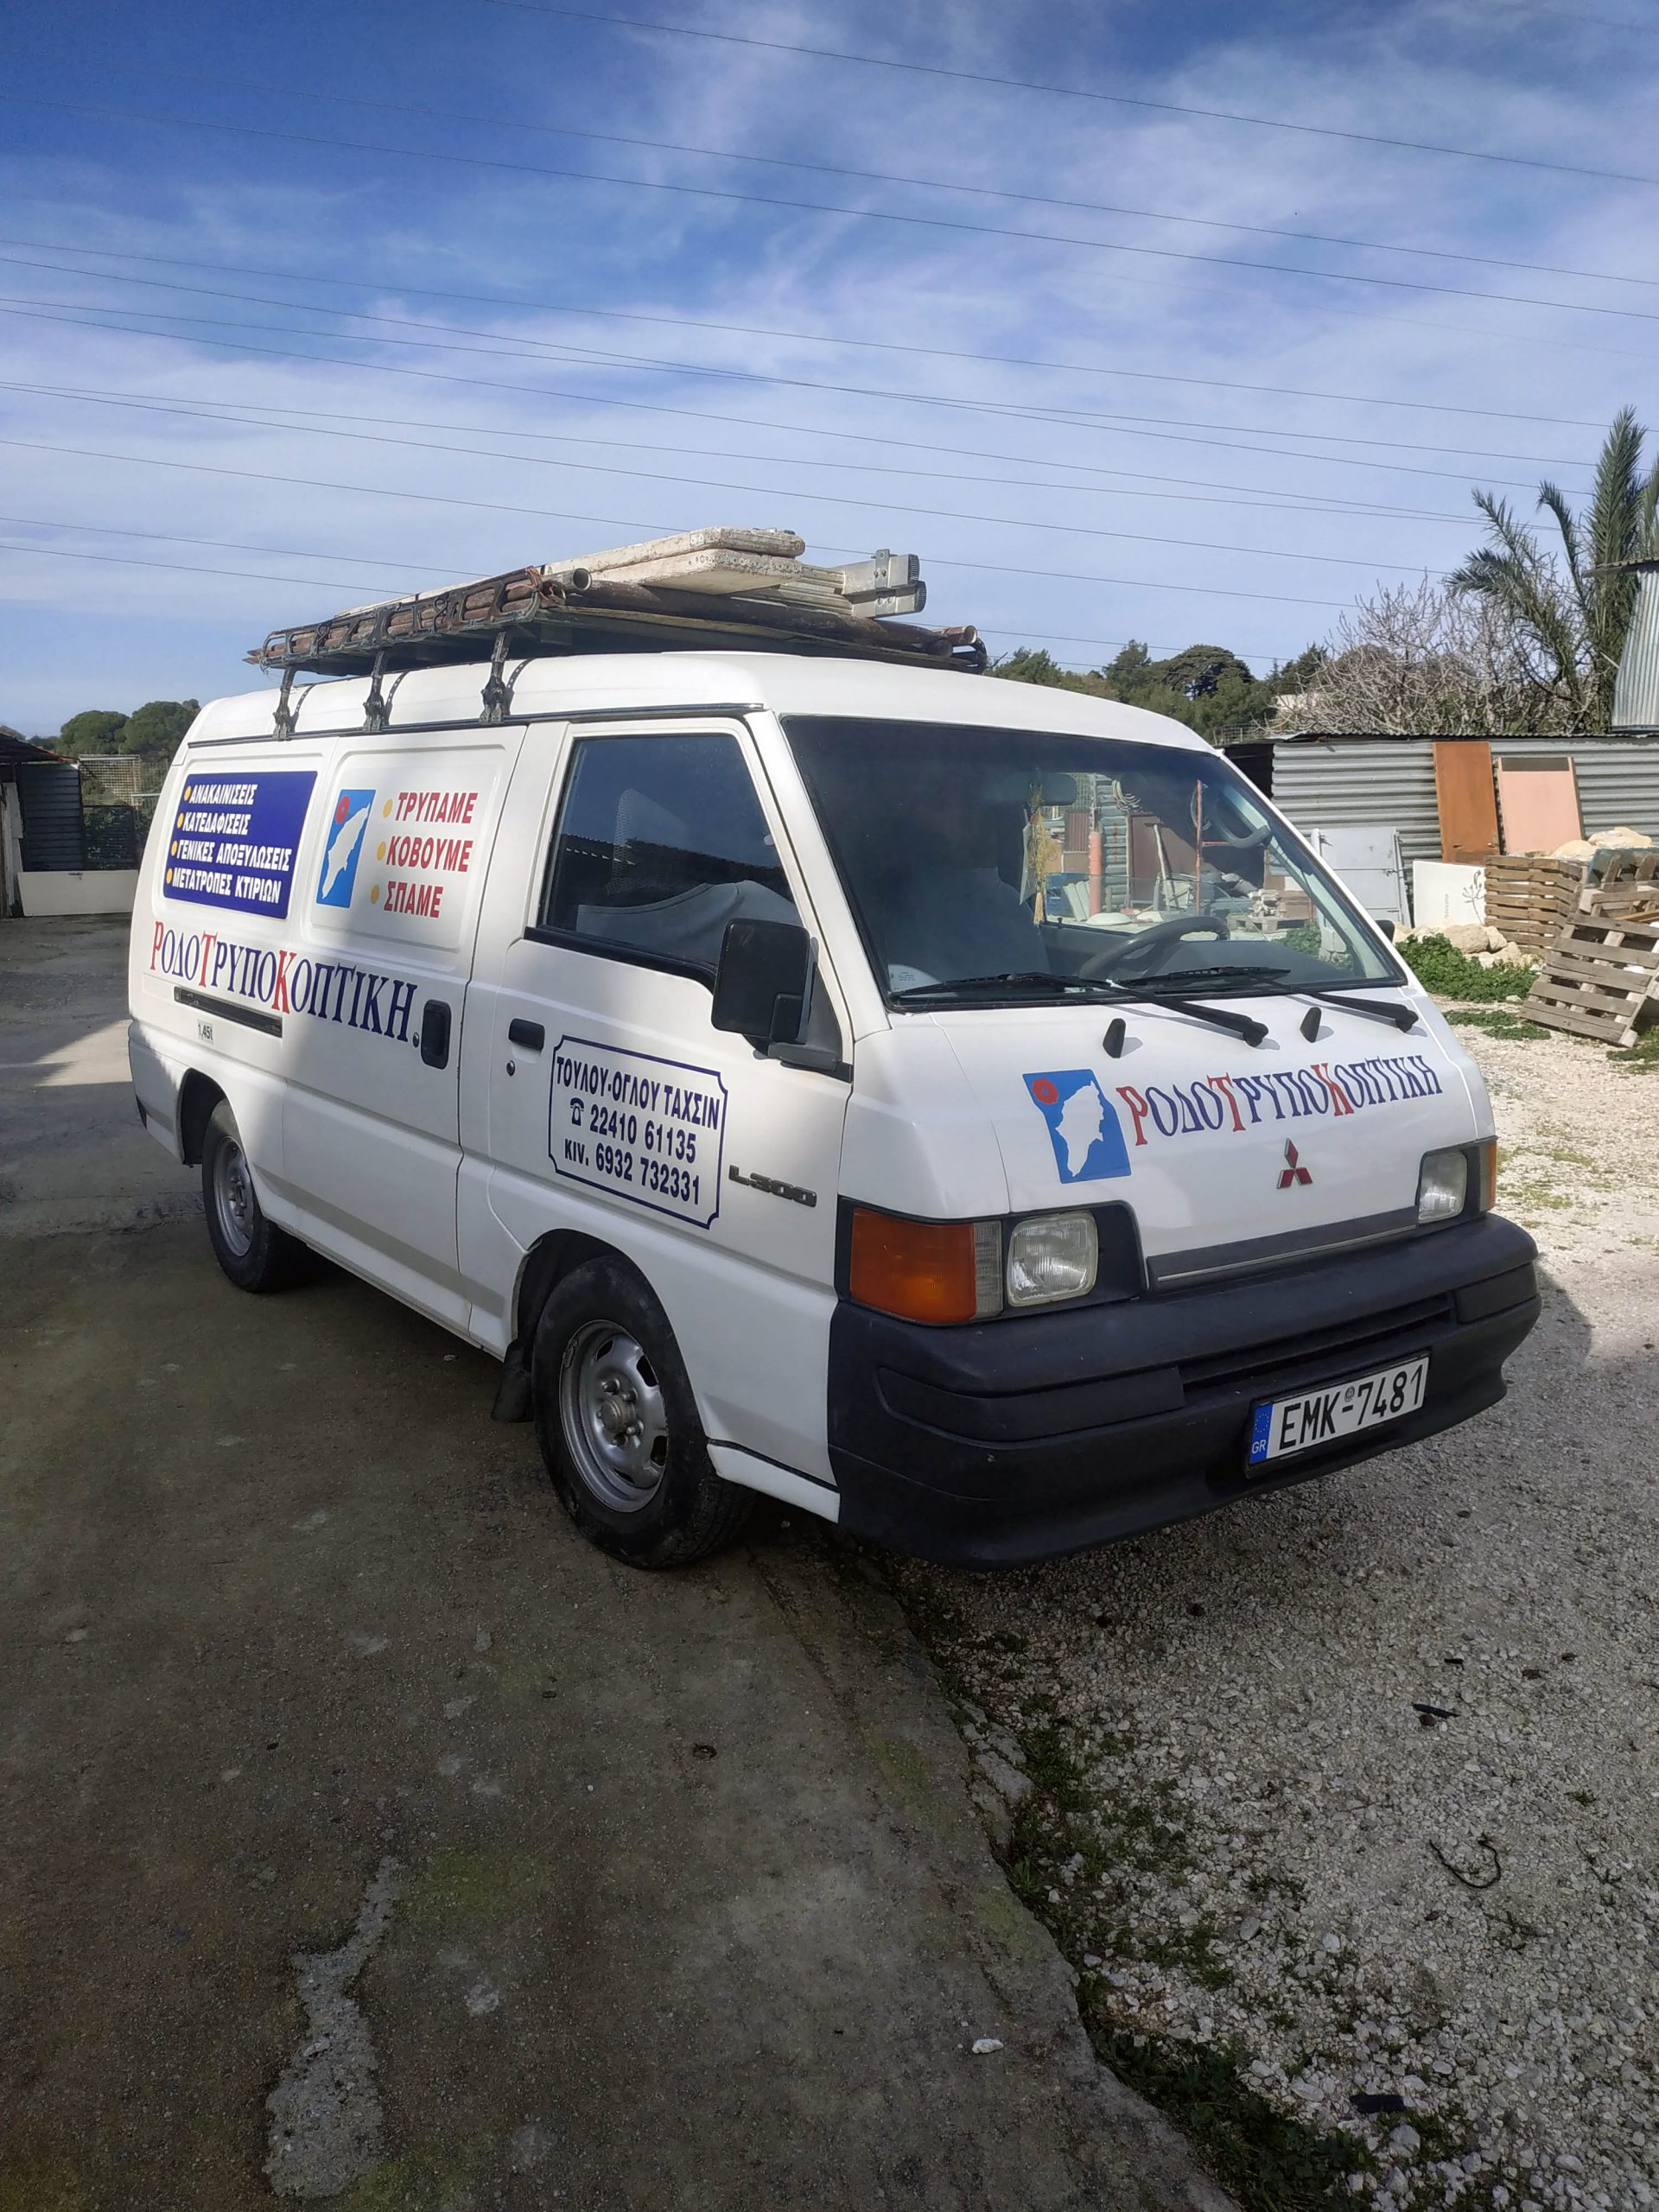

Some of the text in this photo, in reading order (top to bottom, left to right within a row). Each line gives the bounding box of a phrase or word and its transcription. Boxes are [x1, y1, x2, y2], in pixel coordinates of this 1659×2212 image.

[189, 784, 257, 805] ΑΝΑΚΑΙΝΙΣΕΙΣ
[395, 792, 479, 824] ΤΡΥΠΑΜΕ
[182, 812, 251, 836] ΚΑΤΕΔΑΦΙΣΕΙΣ
[176, 840, 292, 872] ΓΕΝΙΚΕΣ ΑΠΟΞΥΛΩΣΕΙΣ
[386, 836, 474, 873] ΚΟΒΟΥΜΕ
[173, 868, 282, 904] ΜΕΤΑΤΡΟΠΕΣ ΚΤΙΡΙΩΝ
[384, 880, 443, 918] ΣΠΑΜΕ
[664, 1085, 720, 1129] ΤΑΧΣΙΝ
[590, 1103, 696, 1163] 22410 61135
[595, 1142, 632, 1182] 6932
[640, 1157, 700, 1205] 732331
[728, 1164, 817, 1208] L300
[1252, 1439, 1266, 1453] GR
